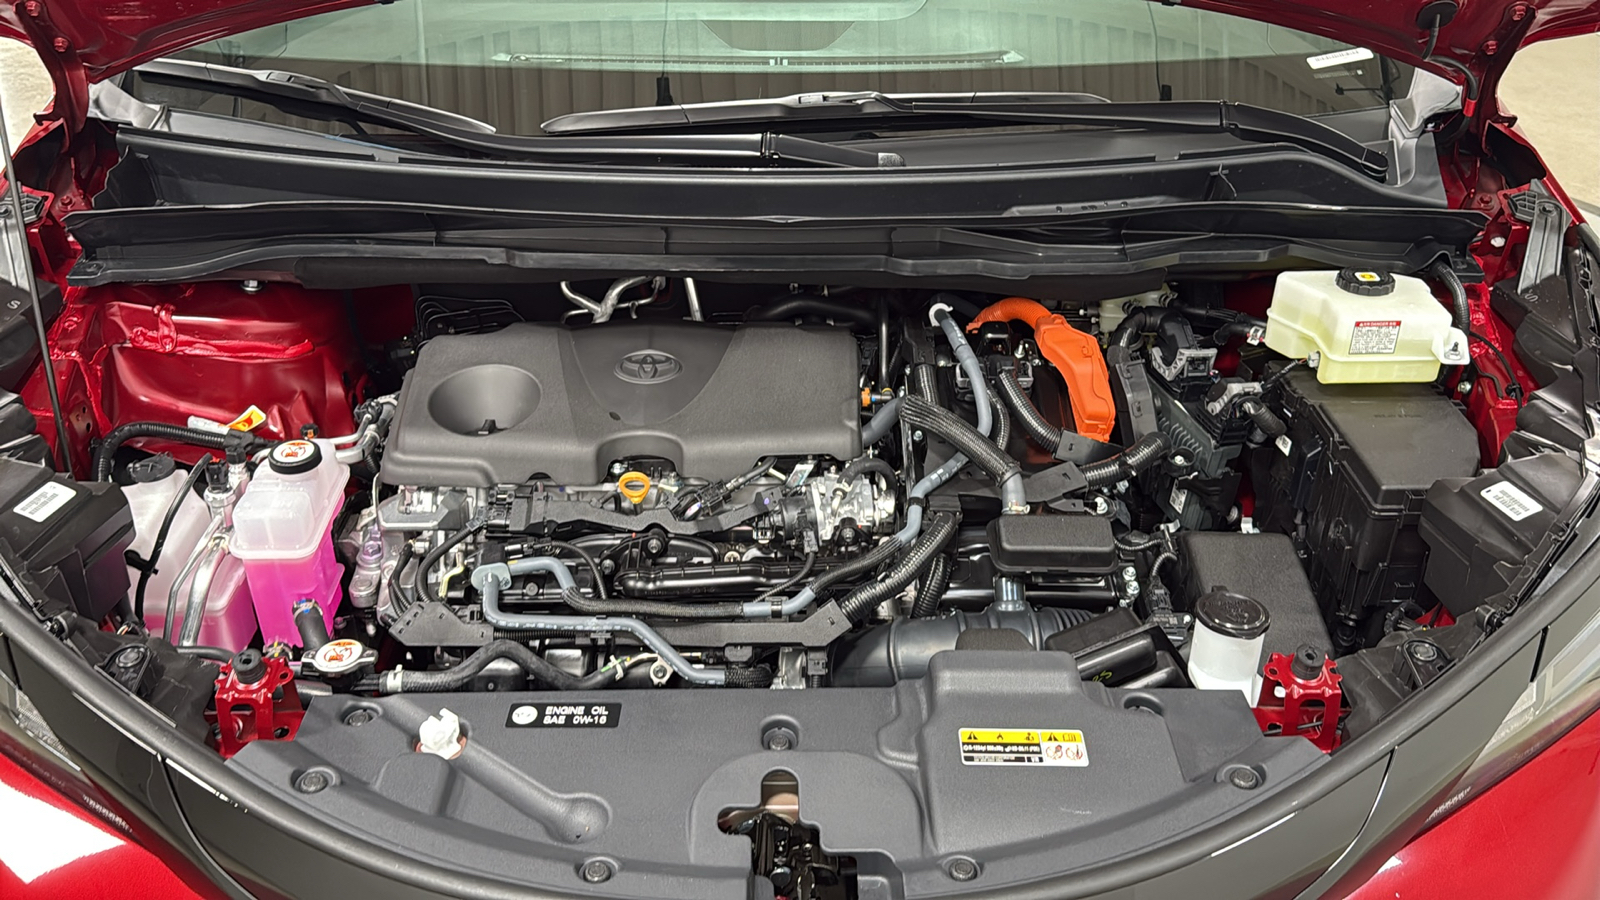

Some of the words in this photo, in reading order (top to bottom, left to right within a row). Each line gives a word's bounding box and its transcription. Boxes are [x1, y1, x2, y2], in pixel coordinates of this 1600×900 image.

[545, 706, 585, 715] ENGINE
[591, 706, 608, 715] OIL
[543, 715, 566, 724] SAE
[573, 715, 607, 724] 0W-16
